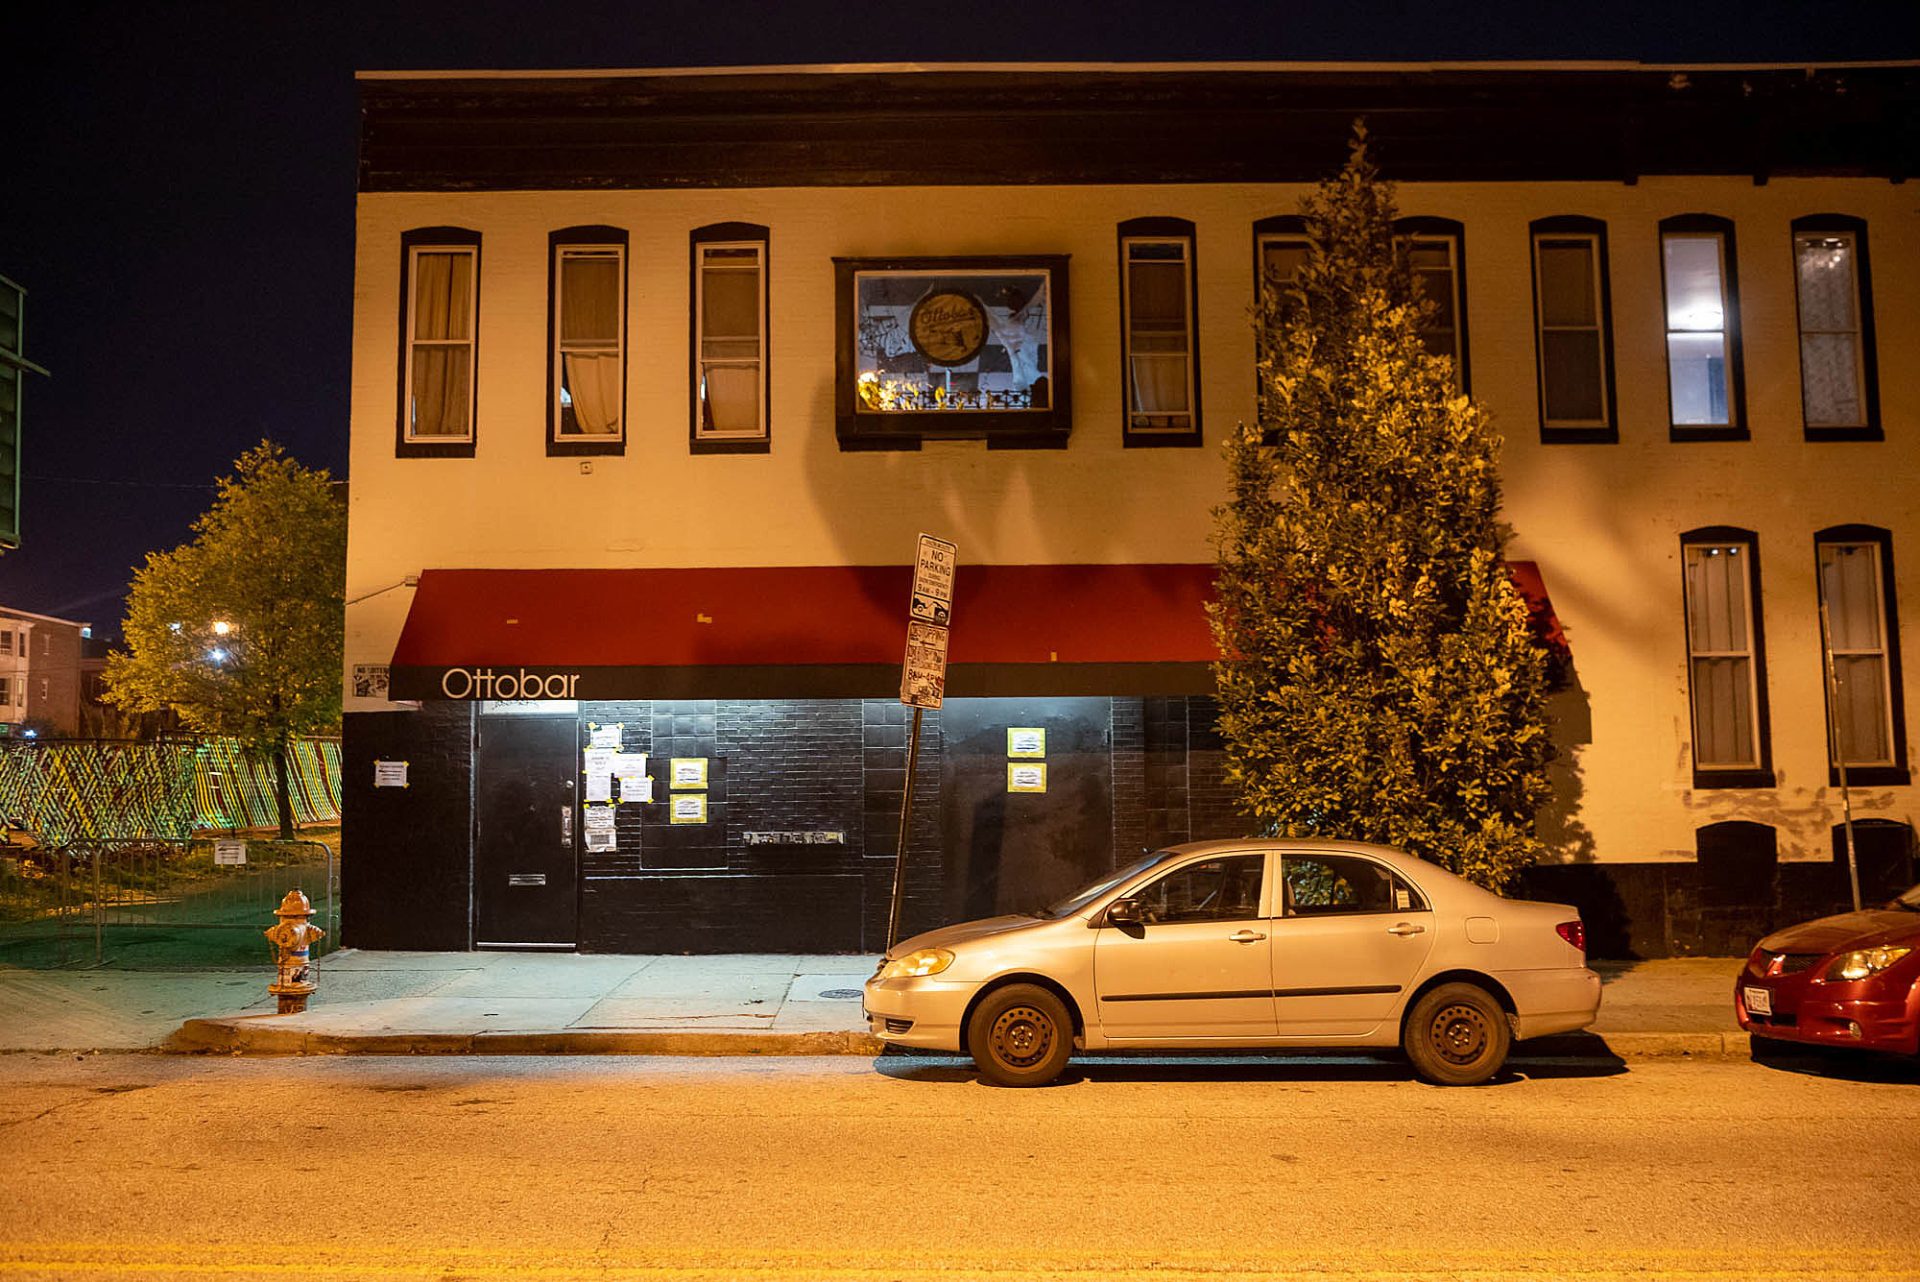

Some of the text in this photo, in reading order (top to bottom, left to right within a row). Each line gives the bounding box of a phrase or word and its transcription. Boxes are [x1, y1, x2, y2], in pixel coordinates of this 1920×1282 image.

[931, 550, 943, 562] NO
[920, 559, 951, 577] PARKING
[442, 668, 580, 699] Ottobar
